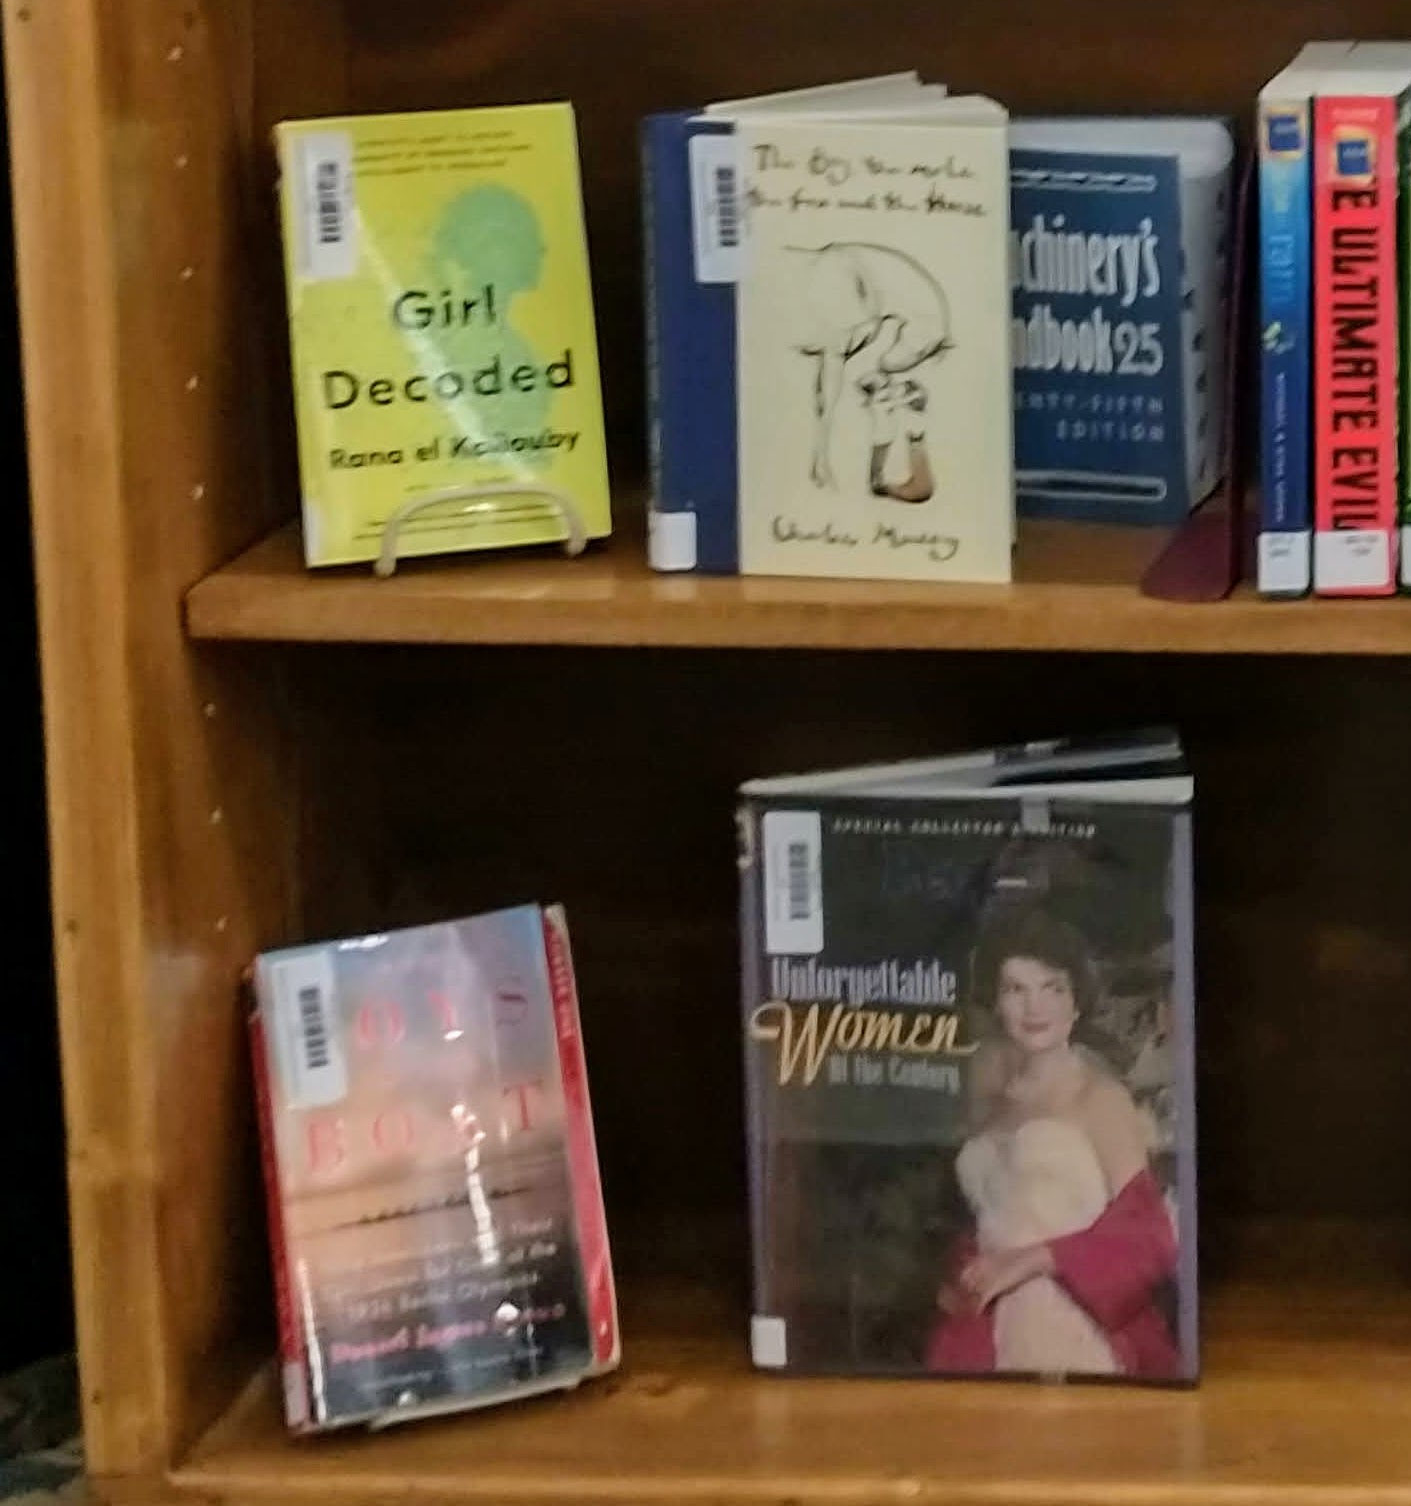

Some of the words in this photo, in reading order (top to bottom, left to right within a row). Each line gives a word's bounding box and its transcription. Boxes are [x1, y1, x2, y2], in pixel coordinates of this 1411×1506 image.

[391, 282, 497, 332] Girl
[1331, 225, 1379, 434] ULTIMATE
[1112, 320, 1165, 377] 25
[322, 346, 576, 411] Decoded
[329, 447, 405, 471] Rana
[413, 439, 441, 462] el
[1055, 419, 1166, 443] EDITION
[1330, 445, 1379, 532] EVIL
[771, 957, 957, 1006] Unforgettable
[748, 1001, 980, 1087] Women
[888, 1057, 961, 1093] Century
